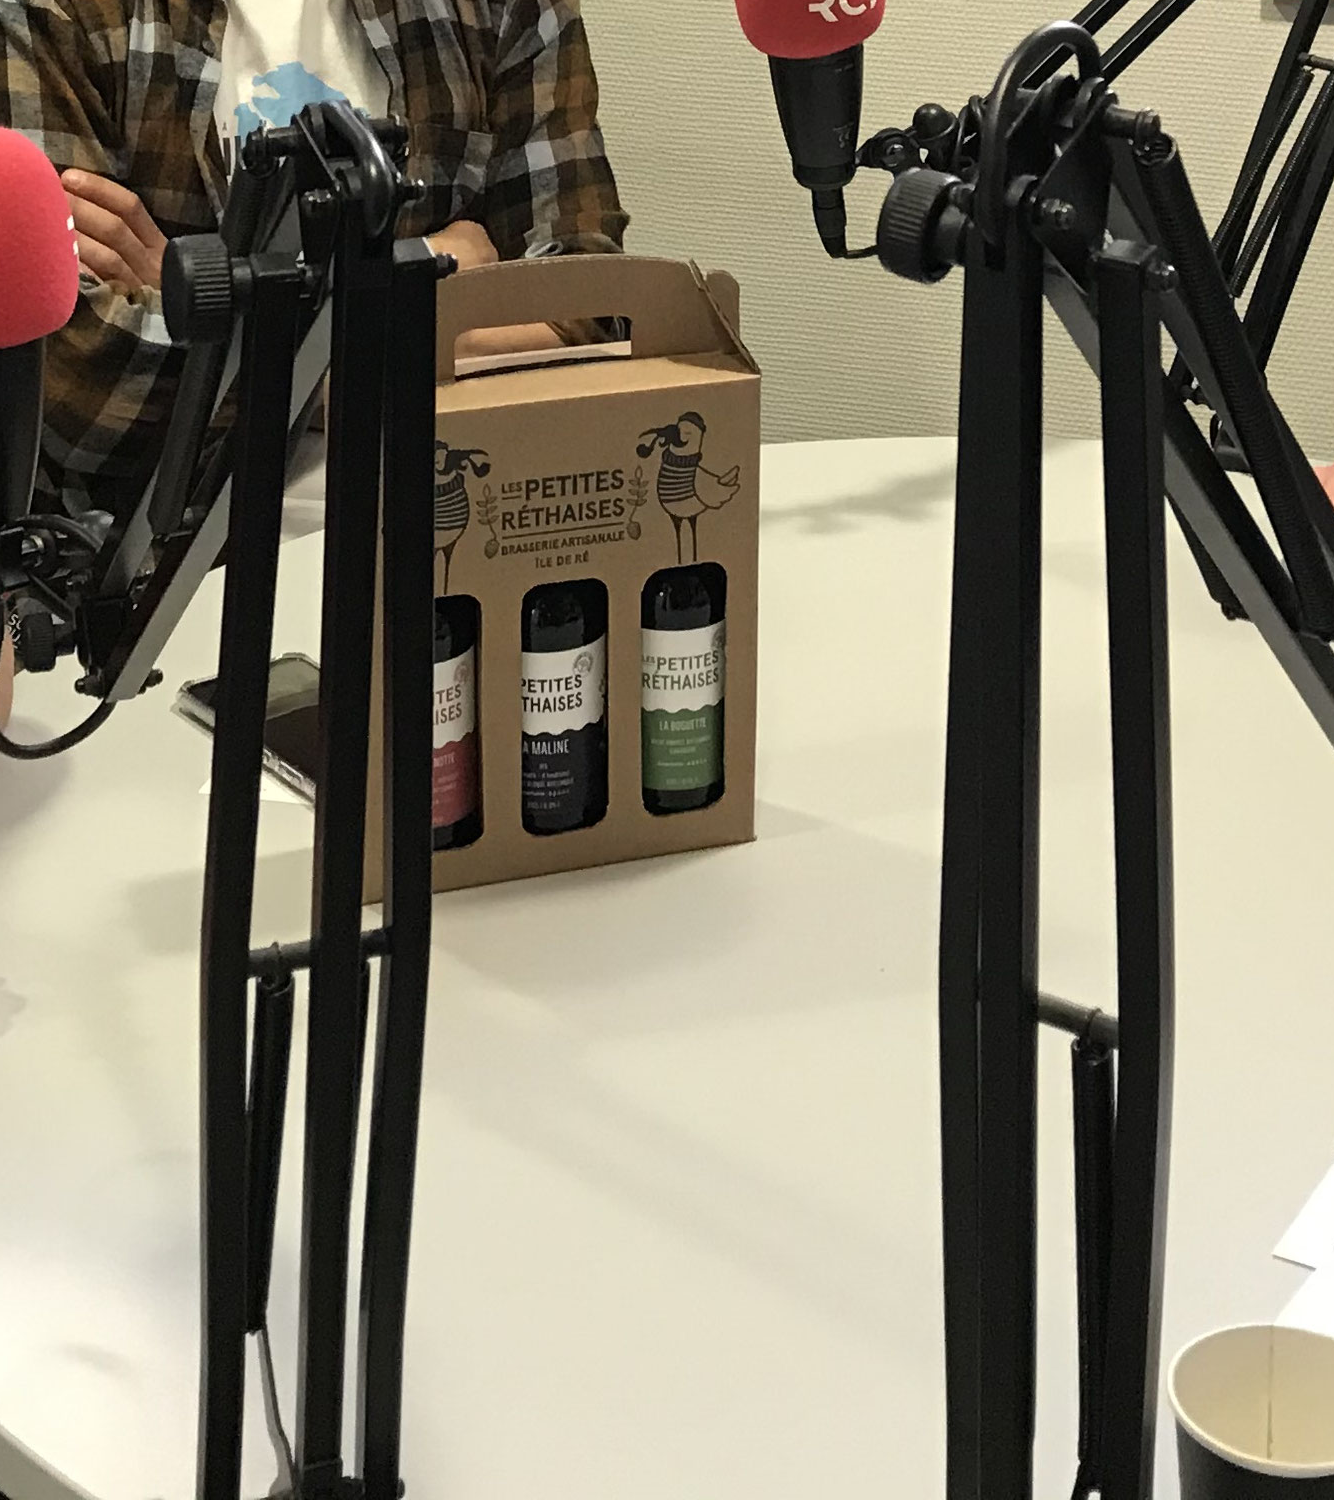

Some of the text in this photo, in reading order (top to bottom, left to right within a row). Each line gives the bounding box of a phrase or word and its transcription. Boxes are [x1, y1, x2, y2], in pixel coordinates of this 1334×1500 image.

[501, 469, 624, 501] LES PETITES
[501, 498, 625, 531] RÉTHAISES
[501, 530, 625, 556] BRASSERIE ARTISANALE
[556, 554, 572, 567] DE
[574, 550, 589, 564] RÉ
[656, 650, 719, 671] PETITES
[642, 667, 719, 690] RÉTHAISES
[521, 692, 583, 713] THAISES
[659, 720, 669, 731] LA
[523, 739, 570, 755] A MALINE
